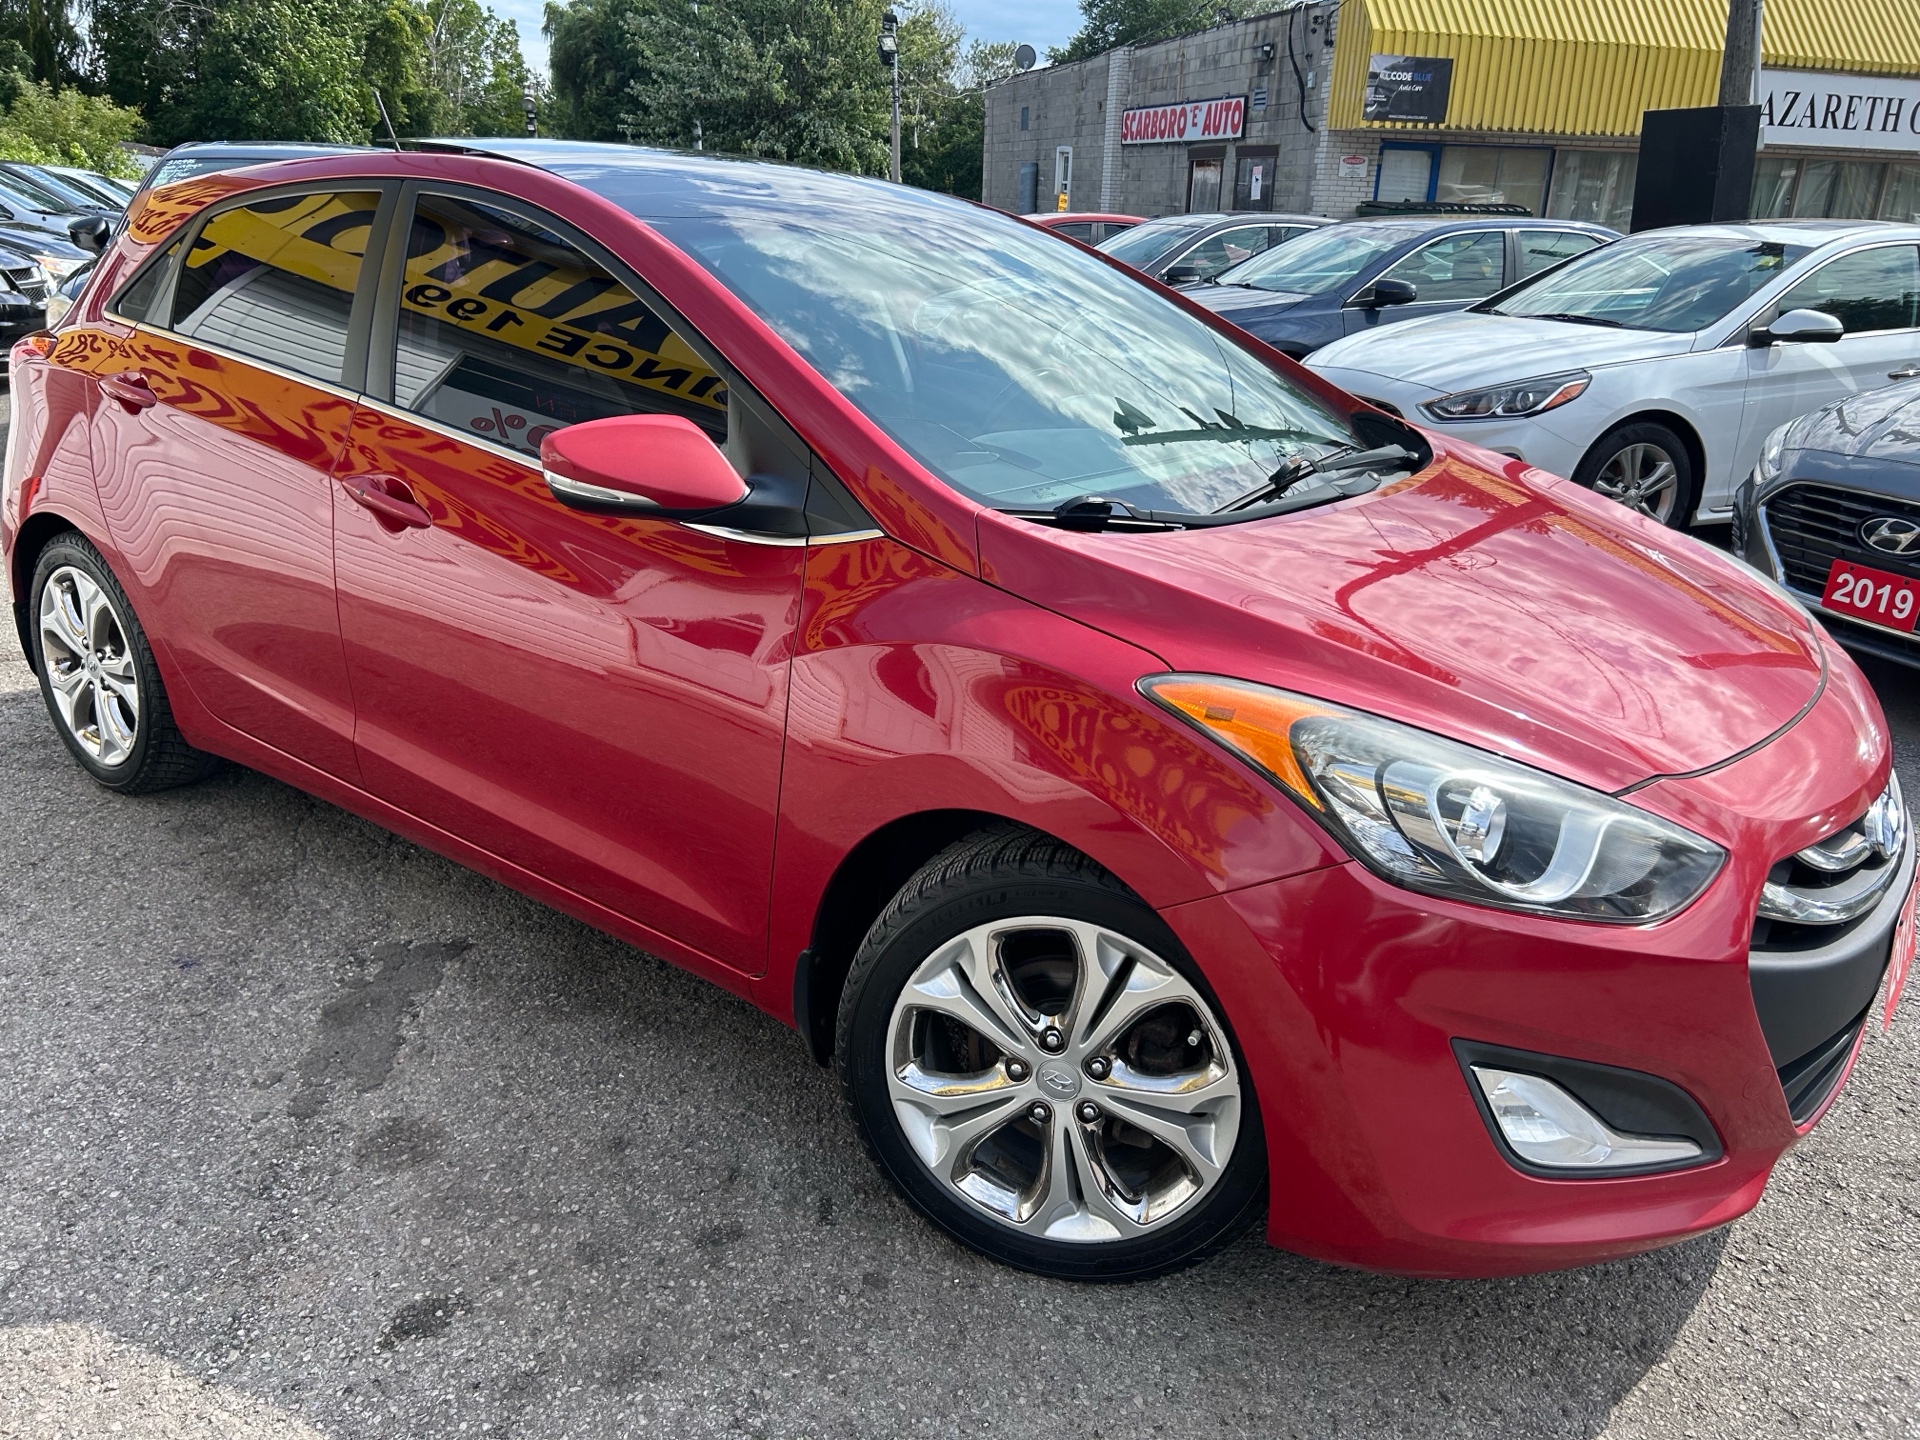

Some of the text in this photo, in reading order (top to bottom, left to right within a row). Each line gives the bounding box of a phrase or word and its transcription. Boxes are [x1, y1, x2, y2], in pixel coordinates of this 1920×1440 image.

[1413, 72, 1433, 82] BLUE
[1121, 106, 1188, 142] SCARBORO
[1202, 99, 1243, 136] AUTO
[1831, 572, 1914, 620] 2019
